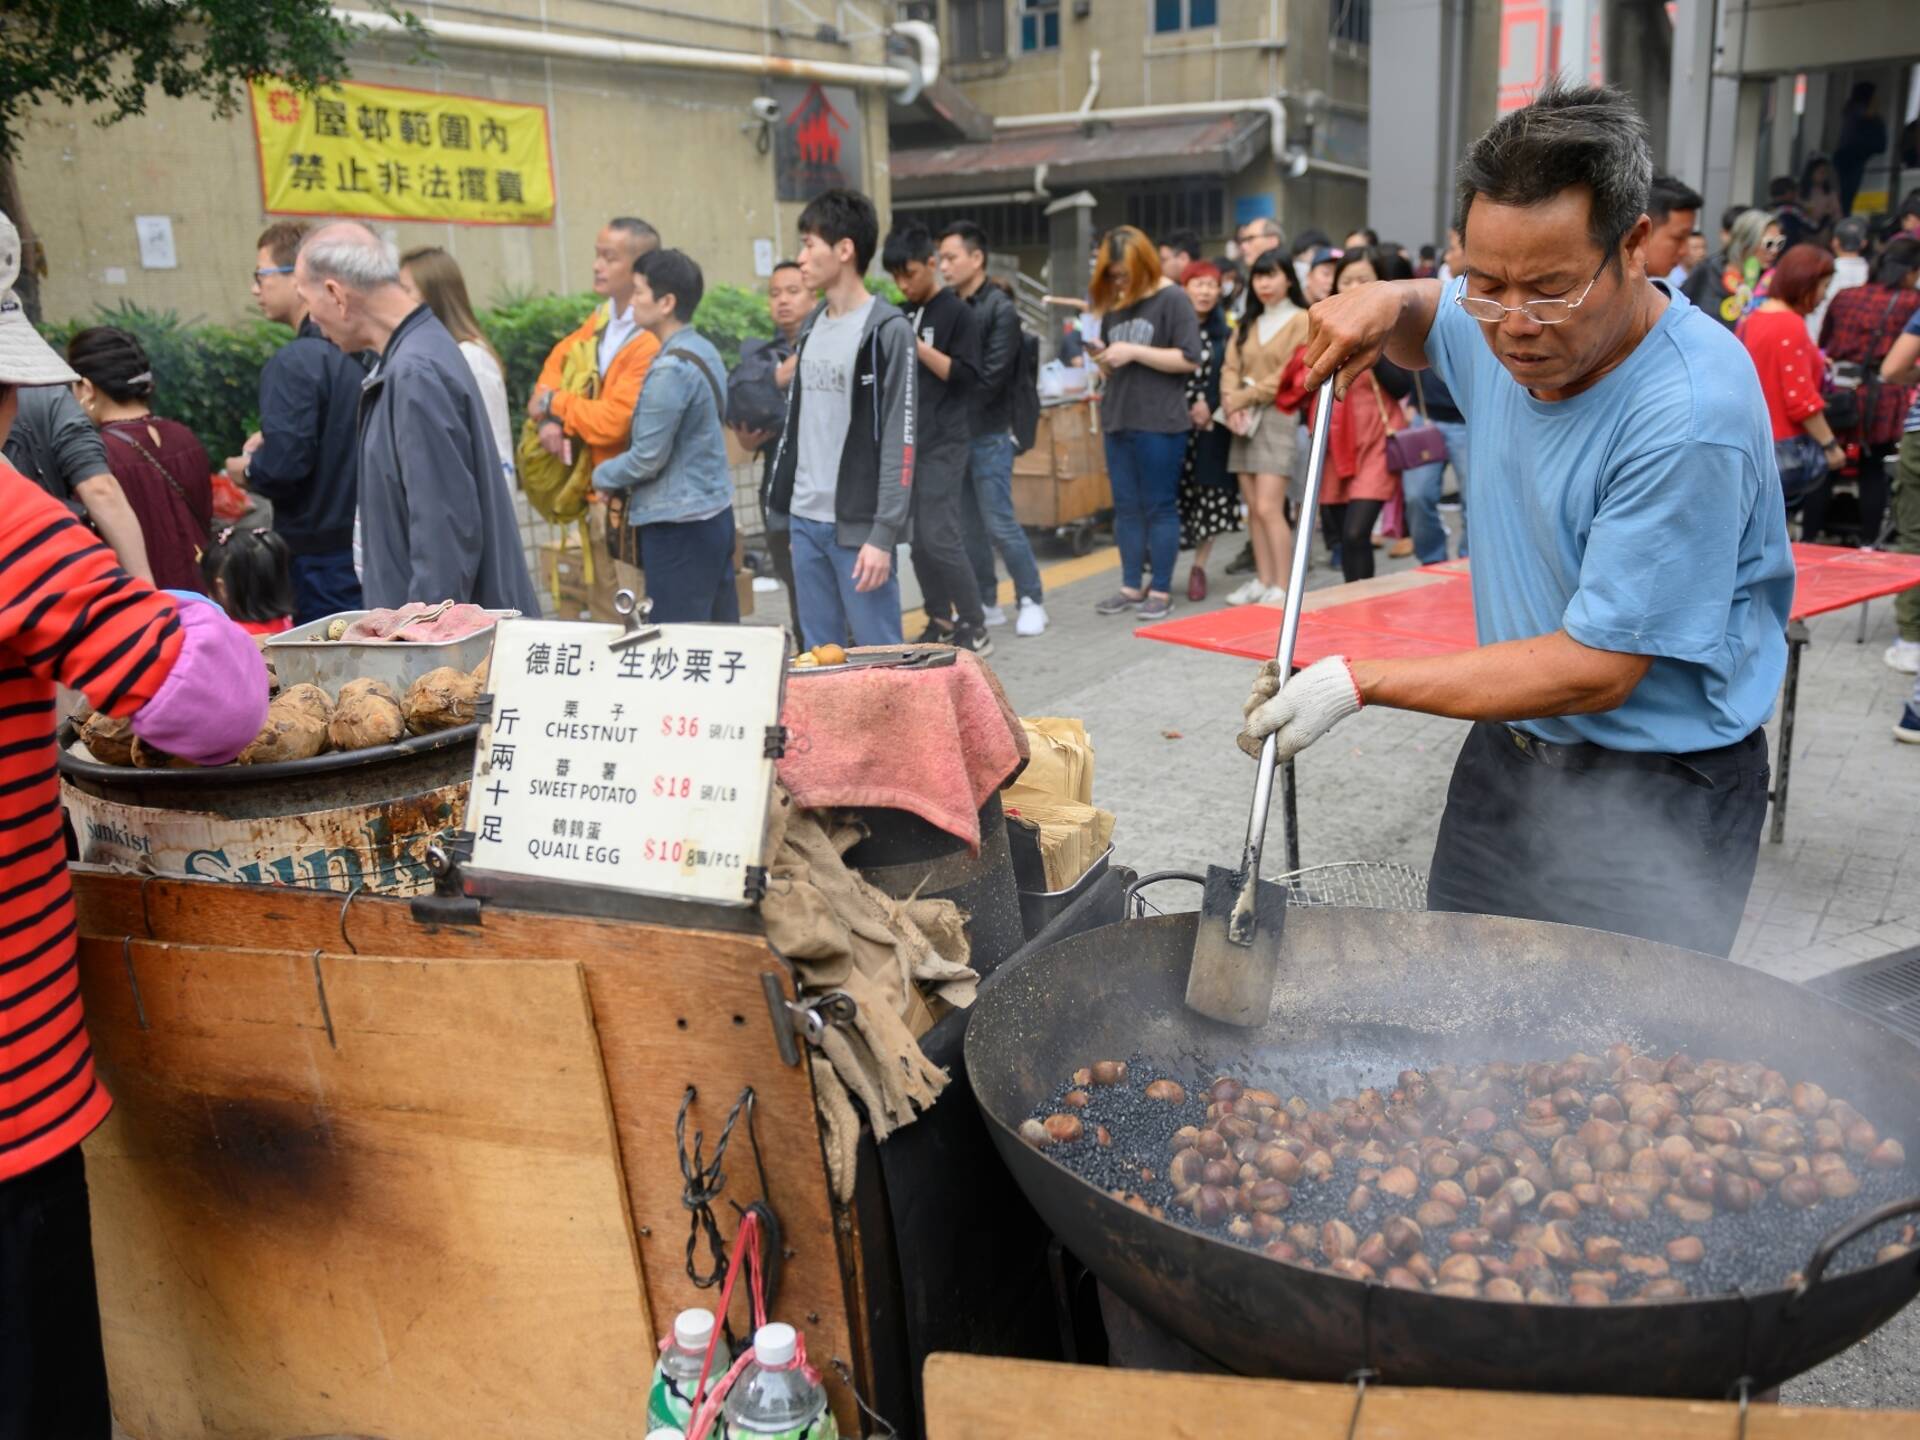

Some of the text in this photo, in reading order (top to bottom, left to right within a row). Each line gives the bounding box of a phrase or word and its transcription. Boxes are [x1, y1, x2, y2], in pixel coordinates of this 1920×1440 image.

[314, 97, 509, 153] 屋邨範圍內
[289, 153, 525, 204] 禁止非法擺賣
[545, 722, 638, 744] CHESTNUT
[479, 707, 521, 844] 斤兩十足
[529, 779, 637, 805] SWEET POTATO
[86, 816, 151, 856] Sunkist
[528, 839, 621, 865] QUAIL EGG
